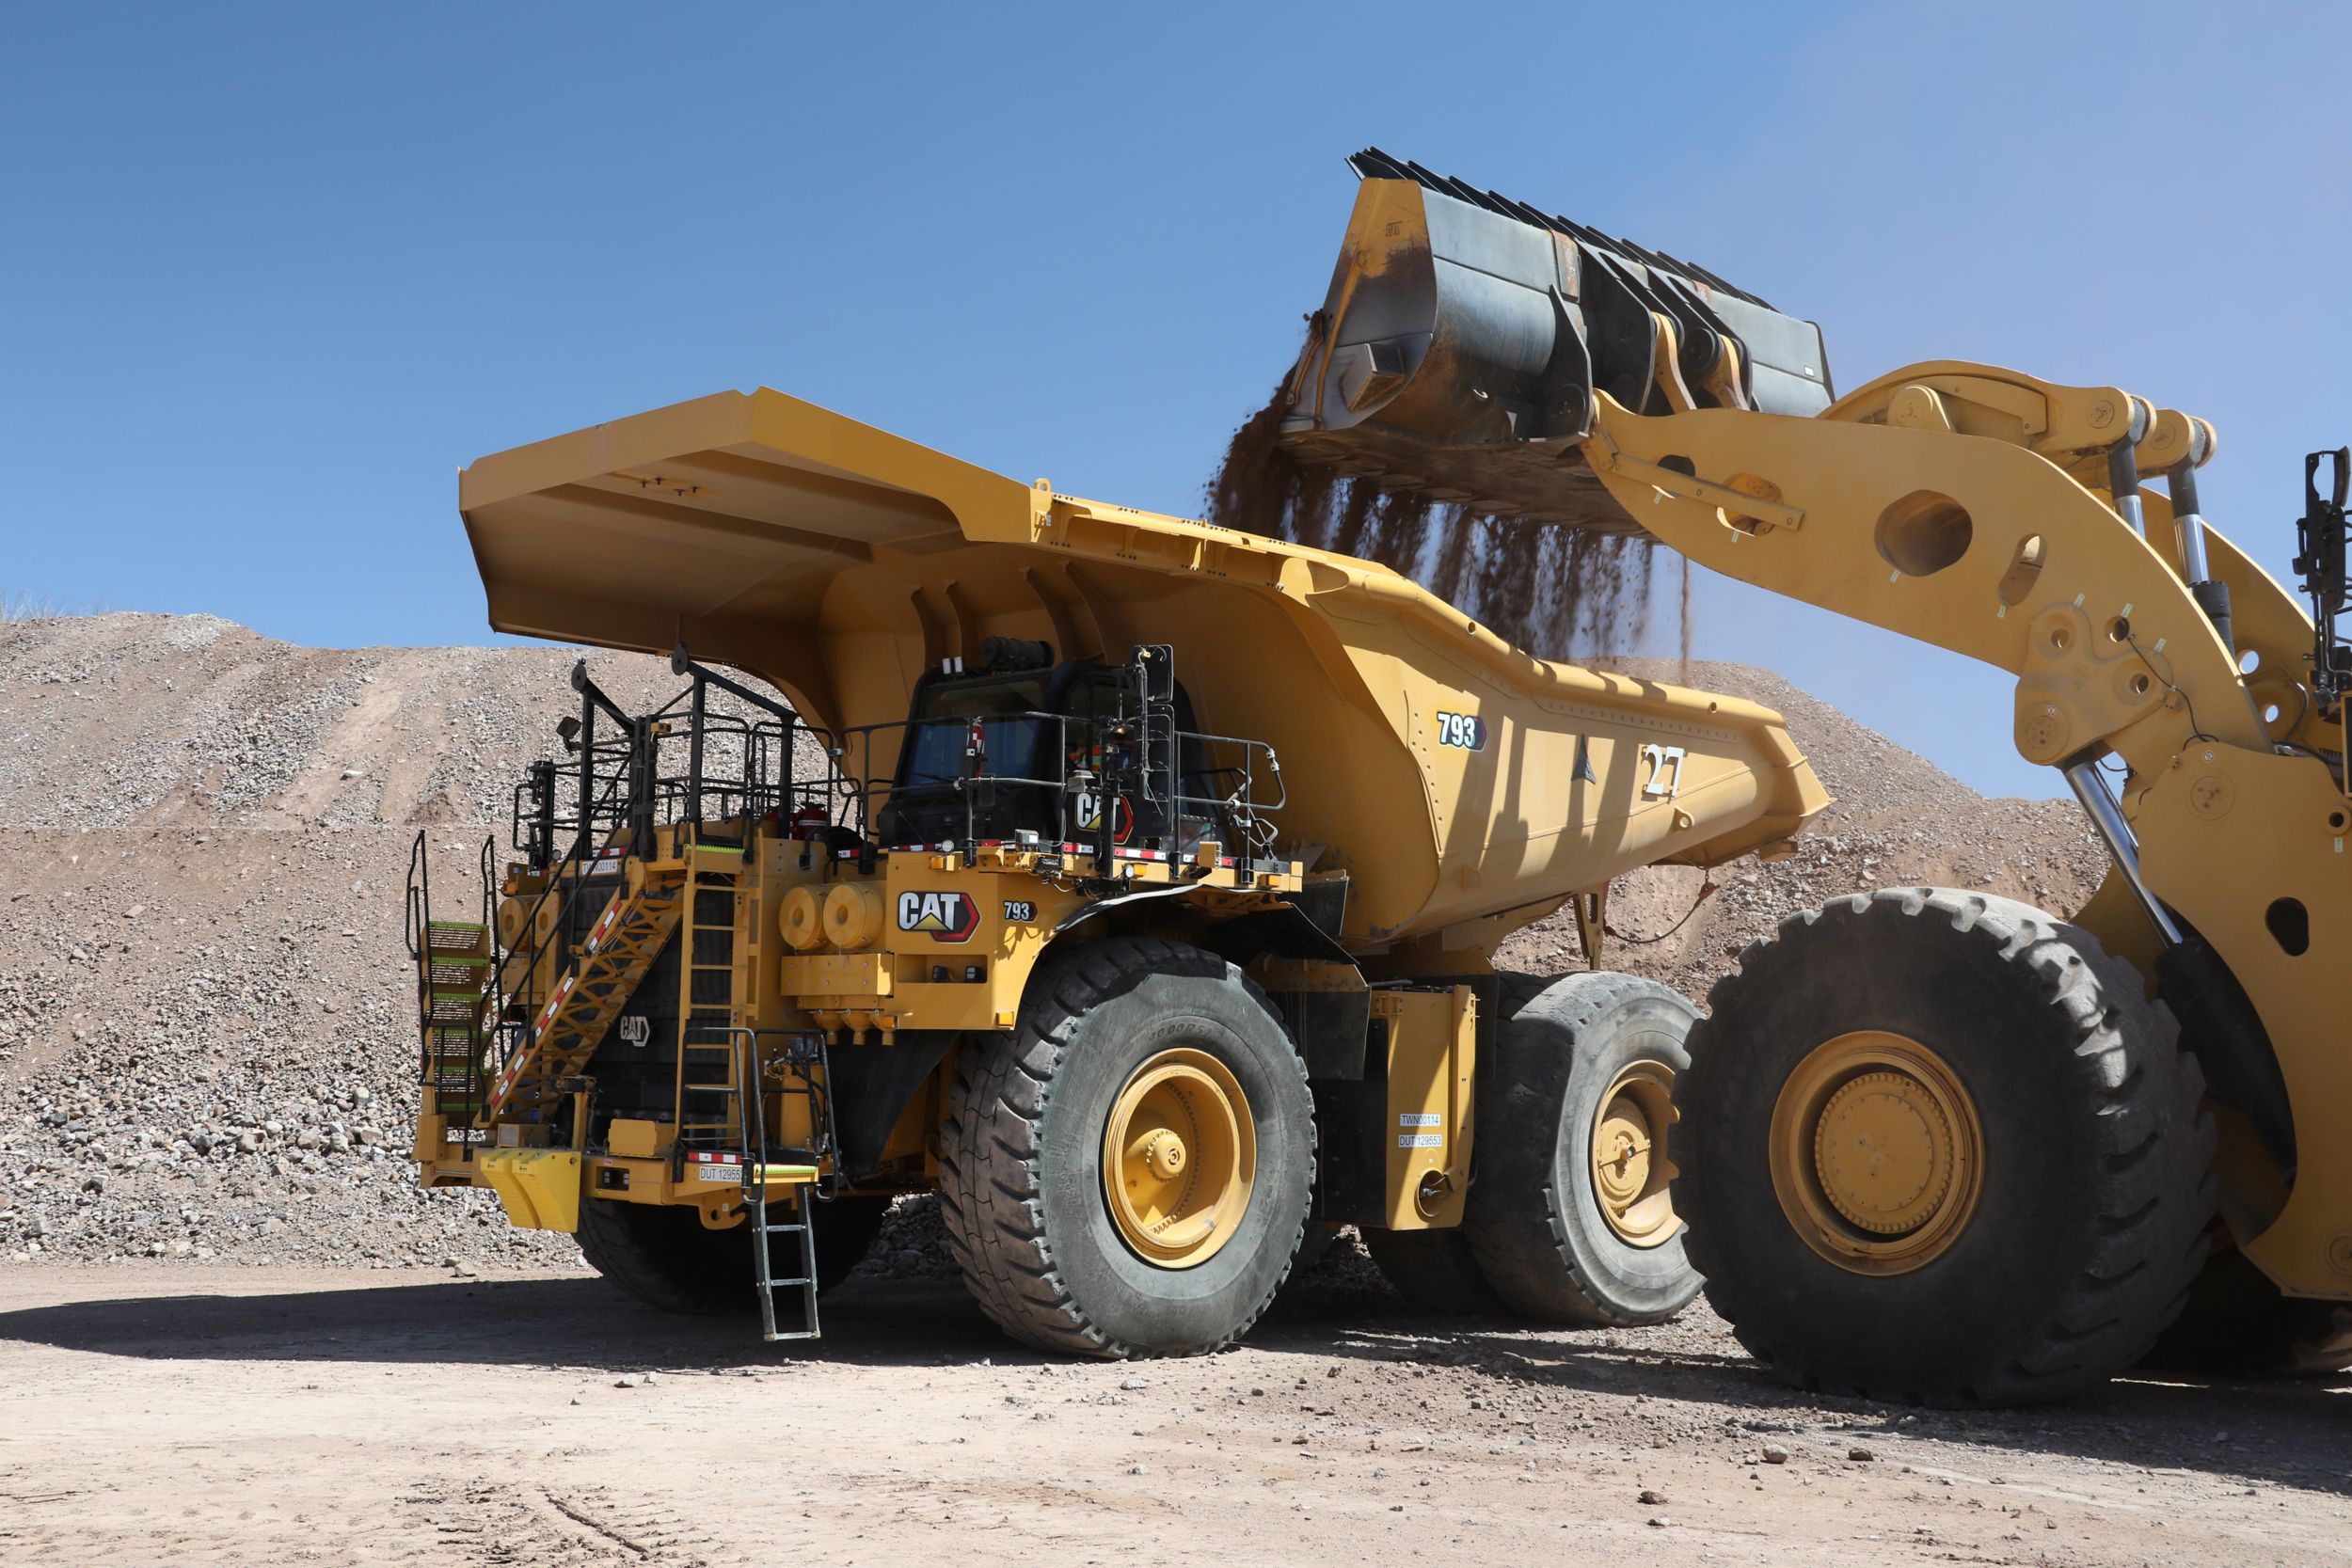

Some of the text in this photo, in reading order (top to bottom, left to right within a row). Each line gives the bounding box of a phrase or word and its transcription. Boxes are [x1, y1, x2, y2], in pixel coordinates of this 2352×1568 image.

[1438, 713, 1475, 748] 793
[1645, 743, 1685, 797] 27
[899, 892, 961, 930] CAT
[1004, 901, 1031, 920] 793
[620, 1016, 645, 1040] CAT
[1401, 1115, 1439, 1125] TWN00114
[1399, 1135, 1441, 1146] DUT 129553
[700, 1167, 743, 1180] DUT 12955
